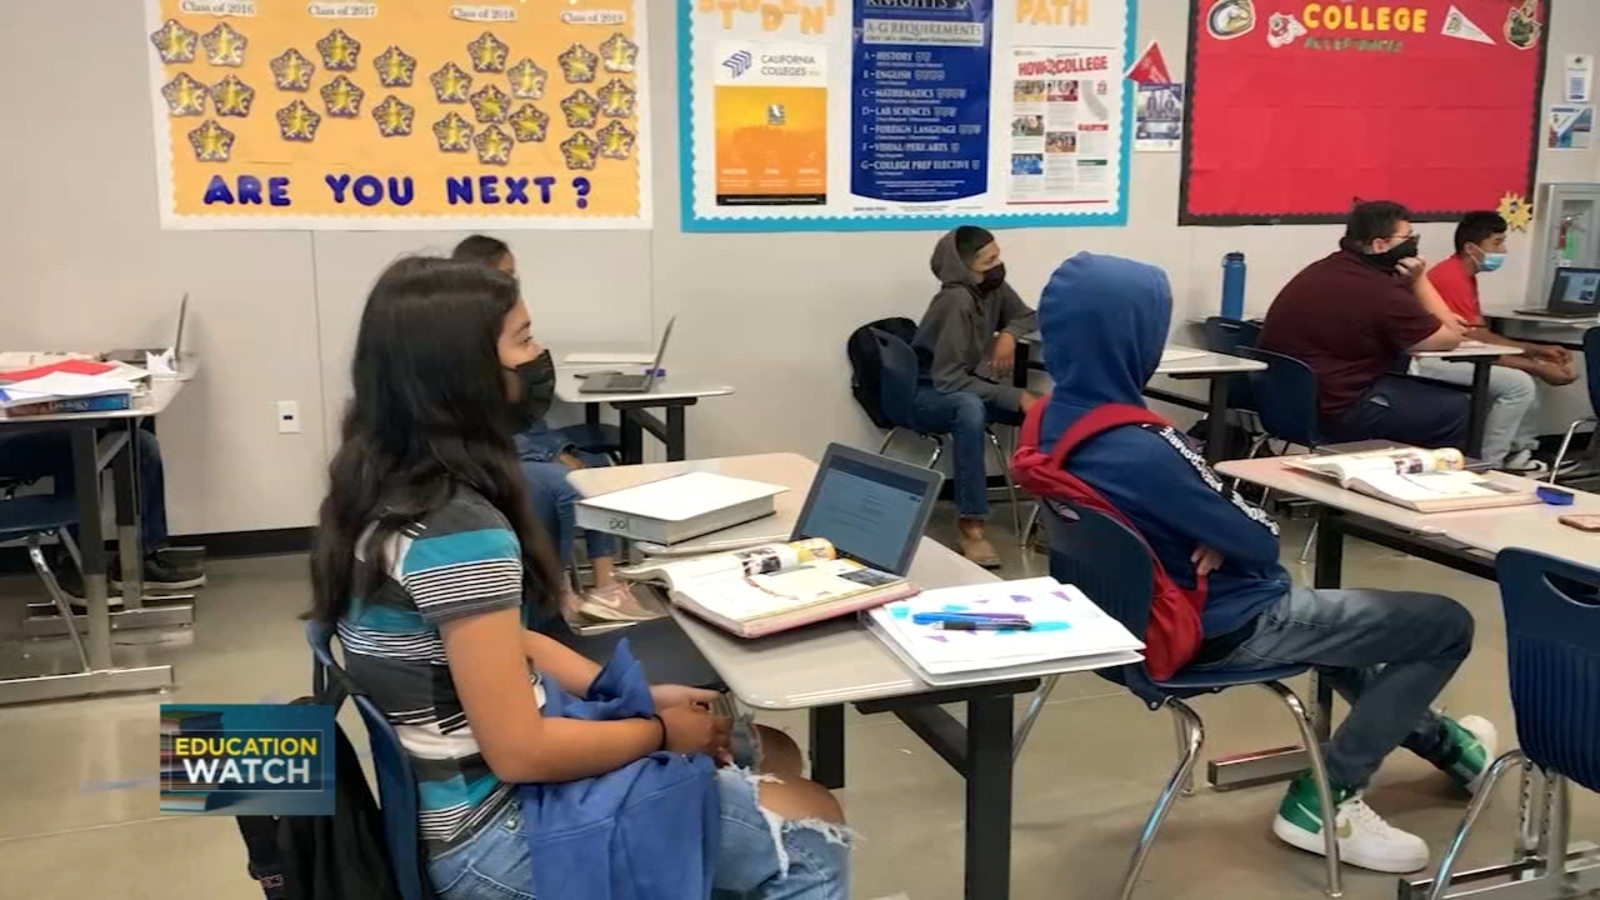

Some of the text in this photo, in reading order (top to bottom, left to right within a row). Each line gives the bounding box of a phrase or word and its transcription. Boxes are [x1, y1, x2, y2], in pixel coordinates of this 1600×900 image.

[182, 1, 253, 14] Class of 2016
[308, 5, 375, 16] Class of 2017
[1015, 0, 1088, 26] PATH
[452, 8, 476, 18] Class
[478, 9, 490, 19] of
[561, 12, 586, 22] Class
[1303, 3, 1427, 33] COLLEGE
[761, 55, 816, 64] CALIFORNIA
[761, 66, 806, 76] COLLEGES
[203, 174, 591, 208] ARE YOU NEXT ?
